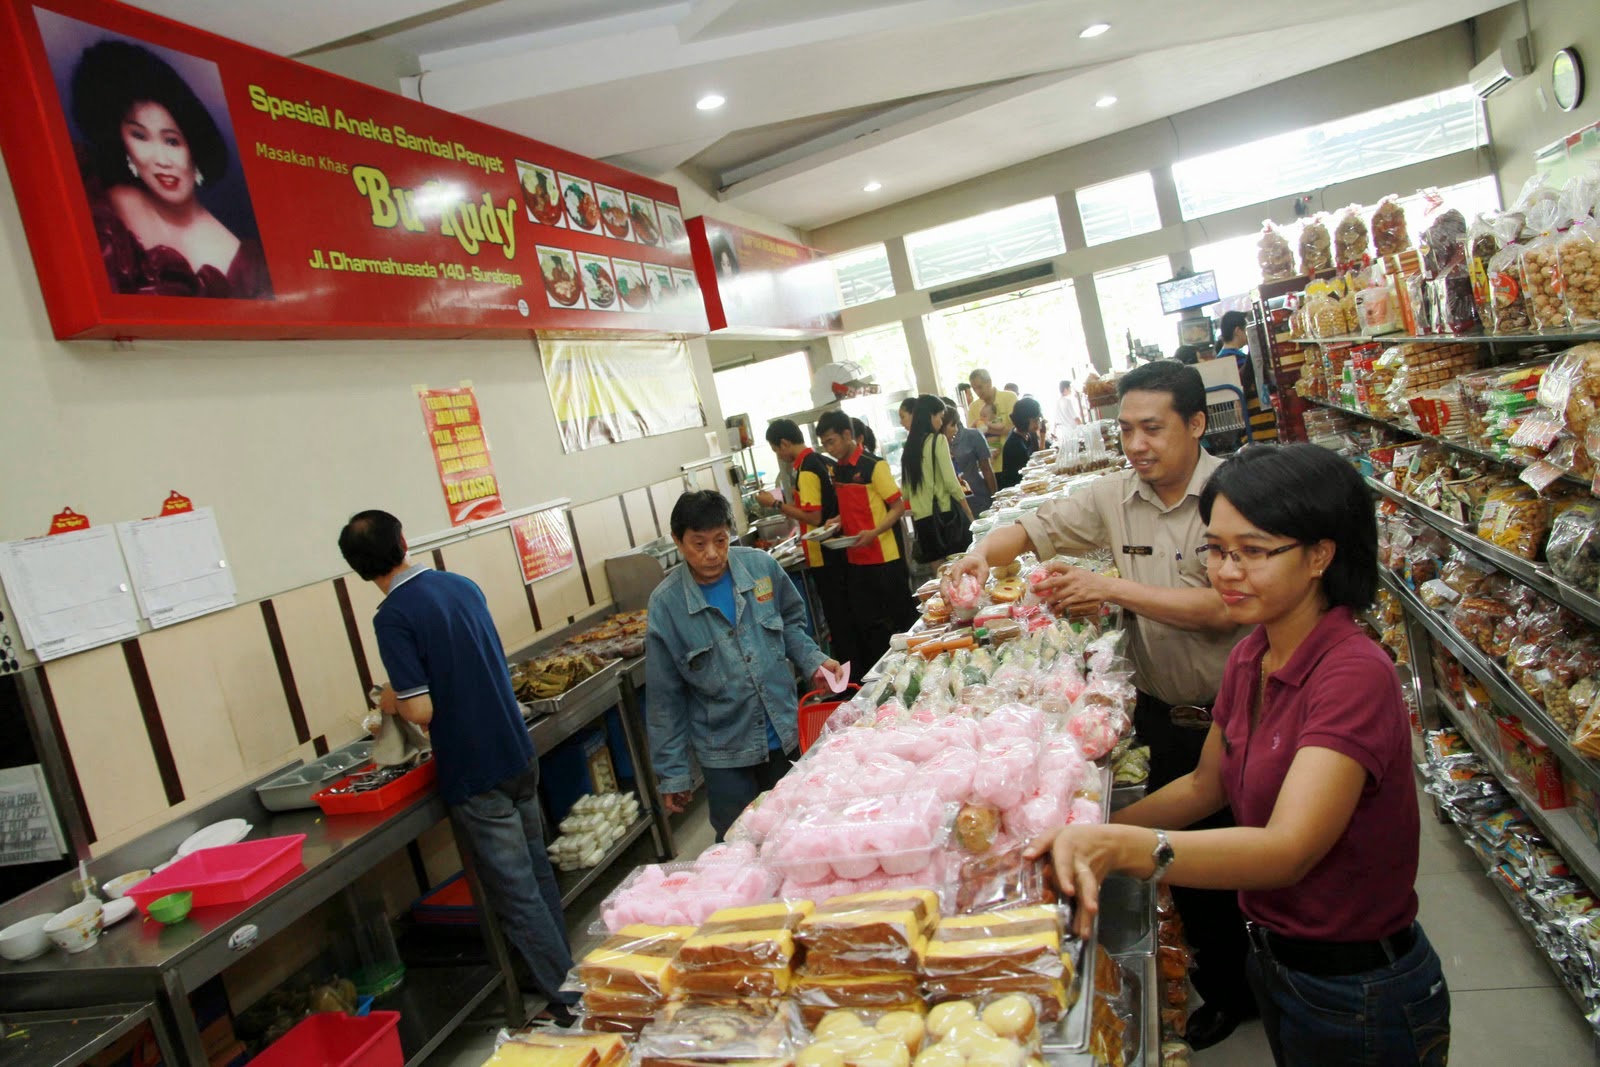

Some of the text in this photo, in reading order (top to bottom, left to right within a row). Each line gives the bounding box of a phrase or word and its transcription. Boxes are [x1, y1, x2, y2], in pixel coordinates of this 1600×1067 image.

[248, 84, 505, 174] Spesial Aneka Sambal Penyet
[255, 142, 349, 175] Masakan Khas
[352, 165, 425, 233] Bu
[329, 251, 438, 278] Dharmahusada
[461, 475, 497, 502] KASIR
